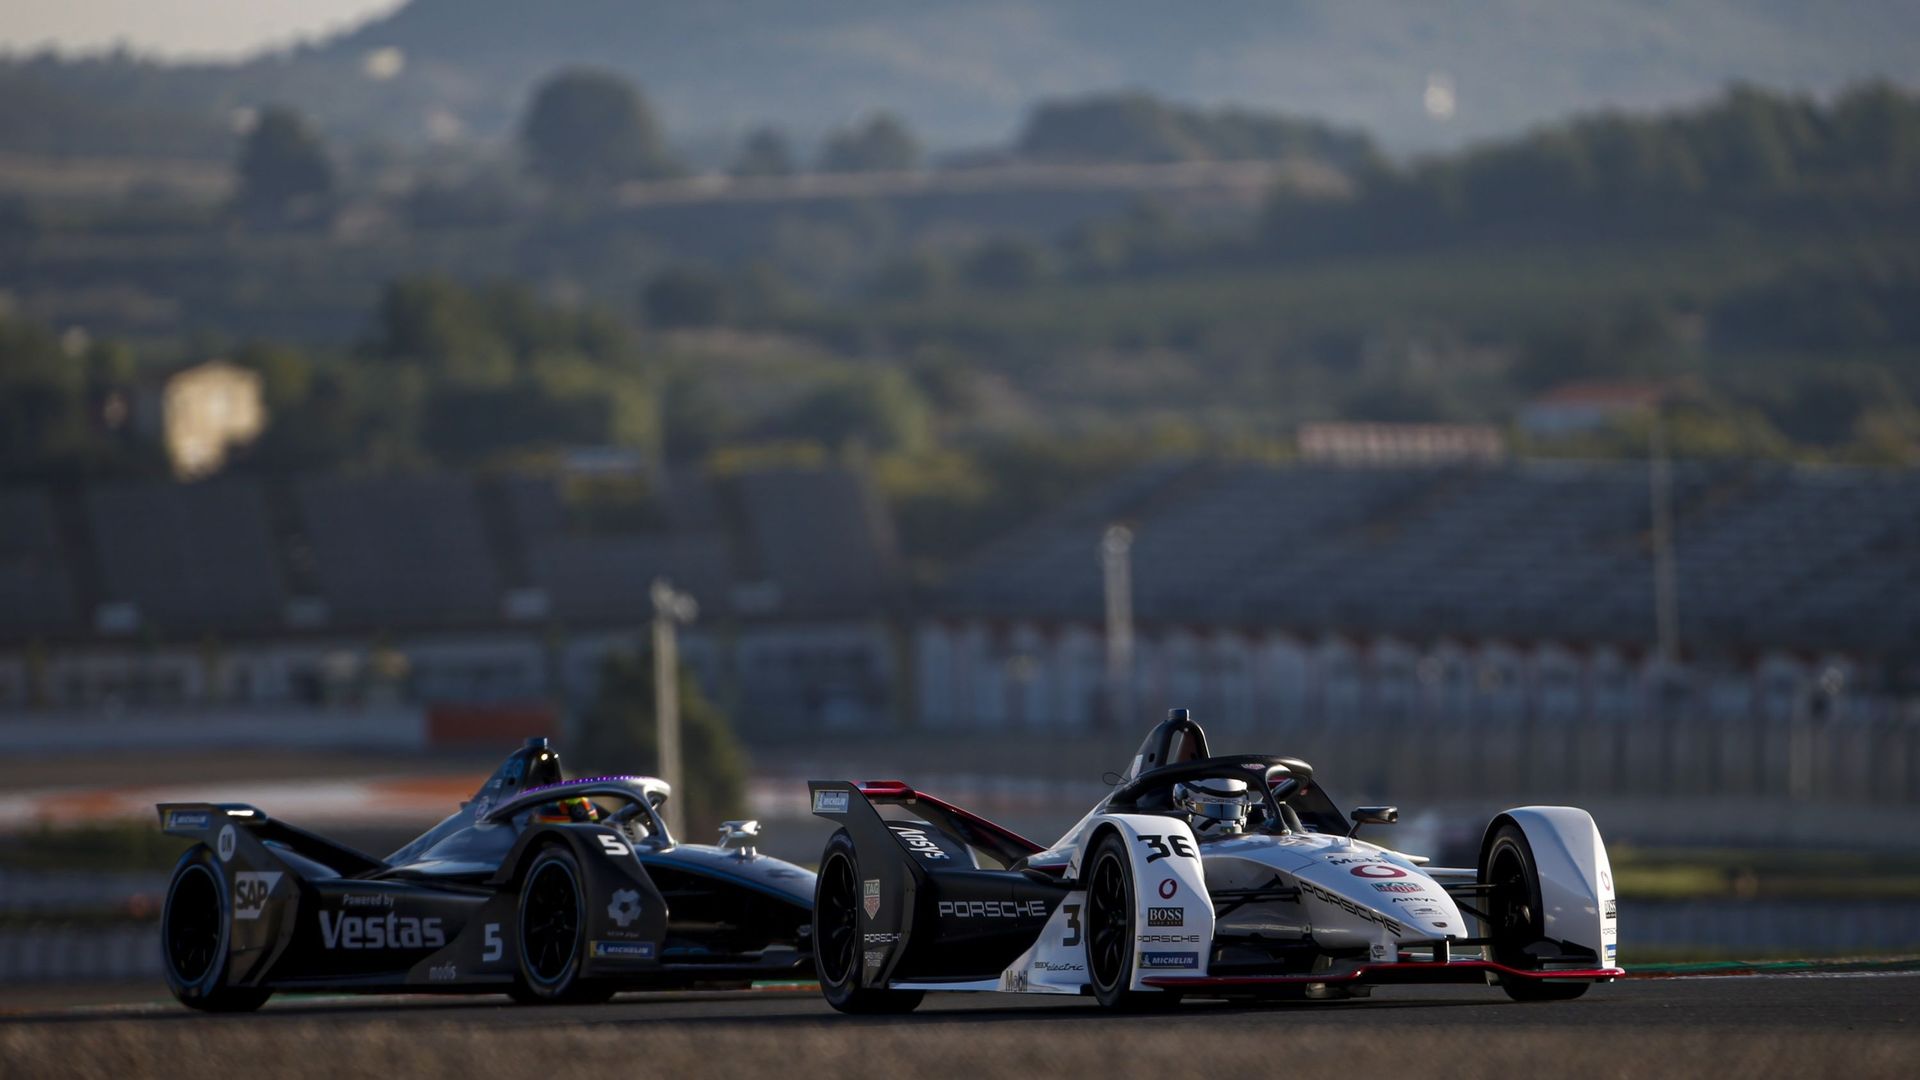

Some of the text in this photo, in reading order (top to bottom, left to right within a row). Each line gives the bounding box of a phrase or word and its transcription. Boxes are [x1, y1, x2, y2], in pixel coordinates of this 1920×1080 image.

[597, 834, 629, 856] 5
[888, 826, 951, 860] Ansys
[1136, 834, 1199, 864] 36
[236, 880, 268, 911] SAP
[865, 883, 880, 895] TAG
[343, 893, 395, 907] Powered by
[937, 900, 1048, 918] PORSCHE
[1300, 880, 1402, 937] PORSCHE
[1150, 909, 1183, 921] BOSS
[317, 909, 447, 950] Vestas
[1137, 935, 1200, 943] PORSCHE
[482, 922, 503, 962] 5
[607, 945, 649, 954] MICHELIN
[1151, 956, 1194, 965] MICHELIN
